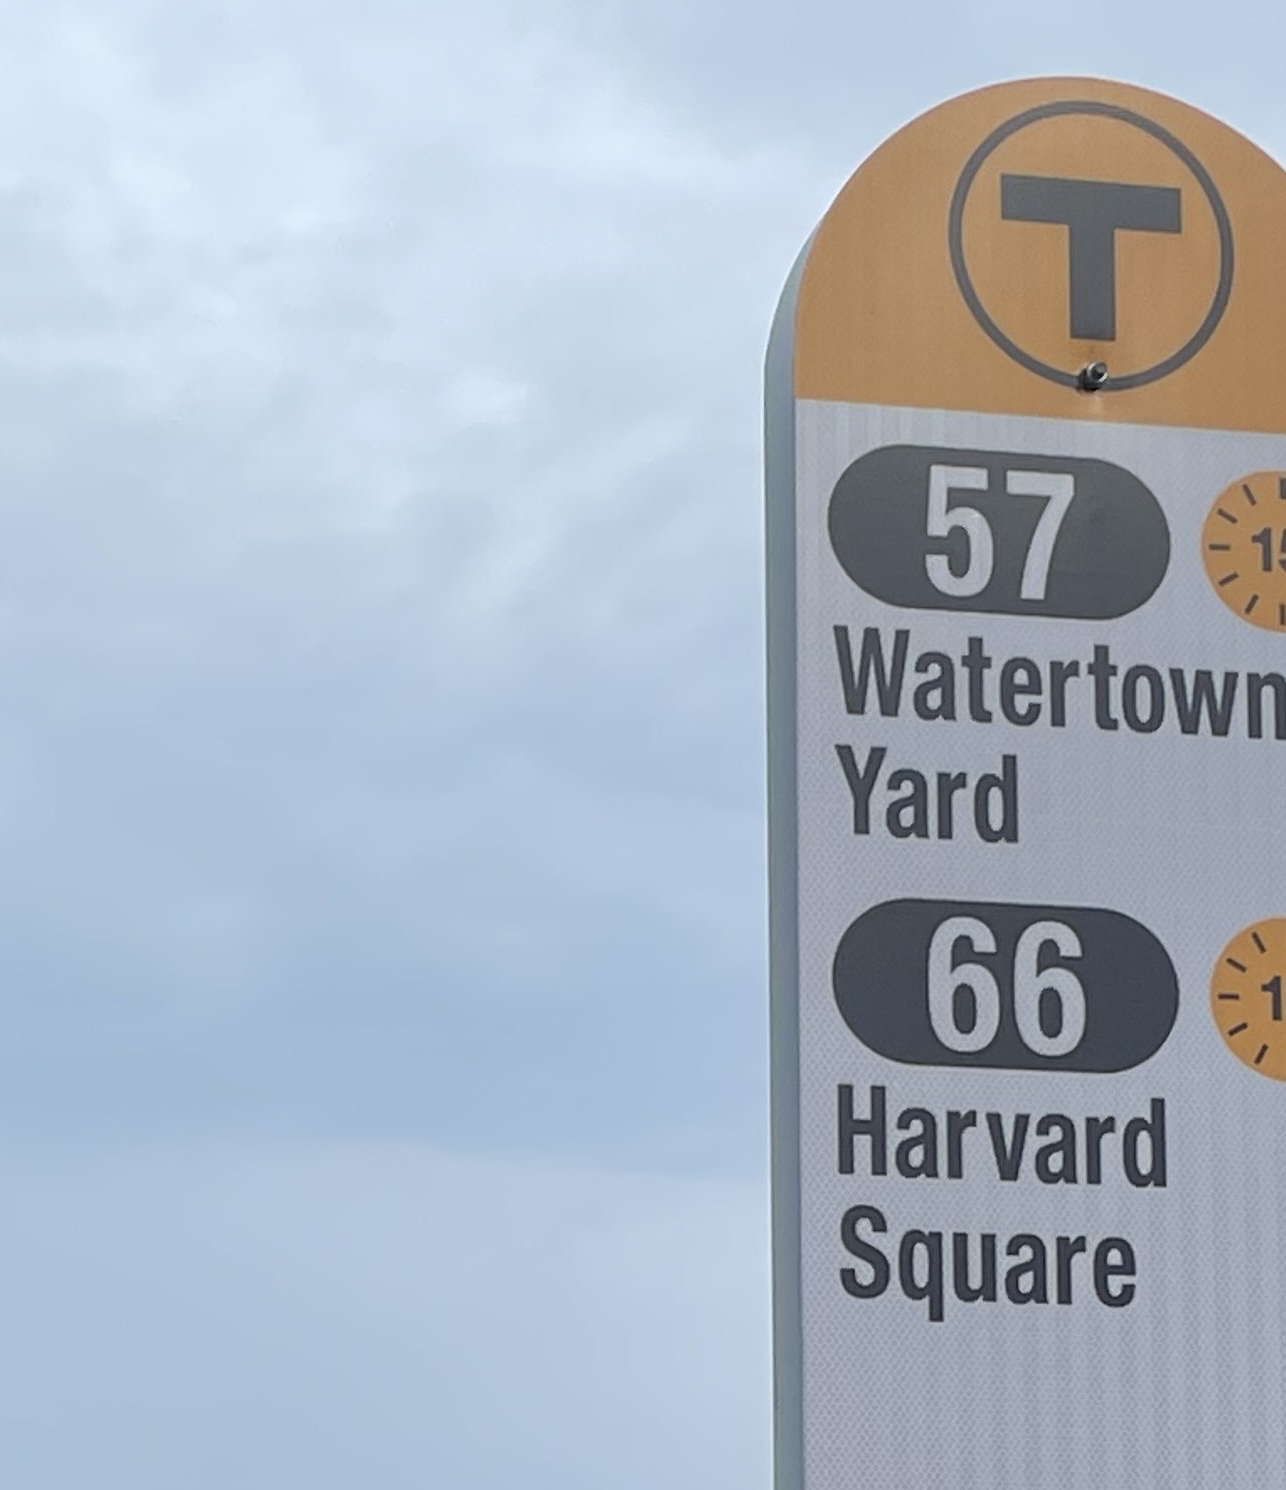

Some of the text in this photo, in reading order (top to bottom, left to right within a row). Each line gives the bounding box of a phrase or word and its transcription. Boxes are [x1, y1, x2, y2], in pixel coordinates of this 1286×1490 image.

[1000, 173, 1182, 341] T
[923, 463, 1076, 602] 57
[835, 744, 1020, 844] Yard
[926, 915, 1087, 1058] 66
[835, 1083, 1168, 1188] Harvard
[839, 1203, 1137, 1323] Square
